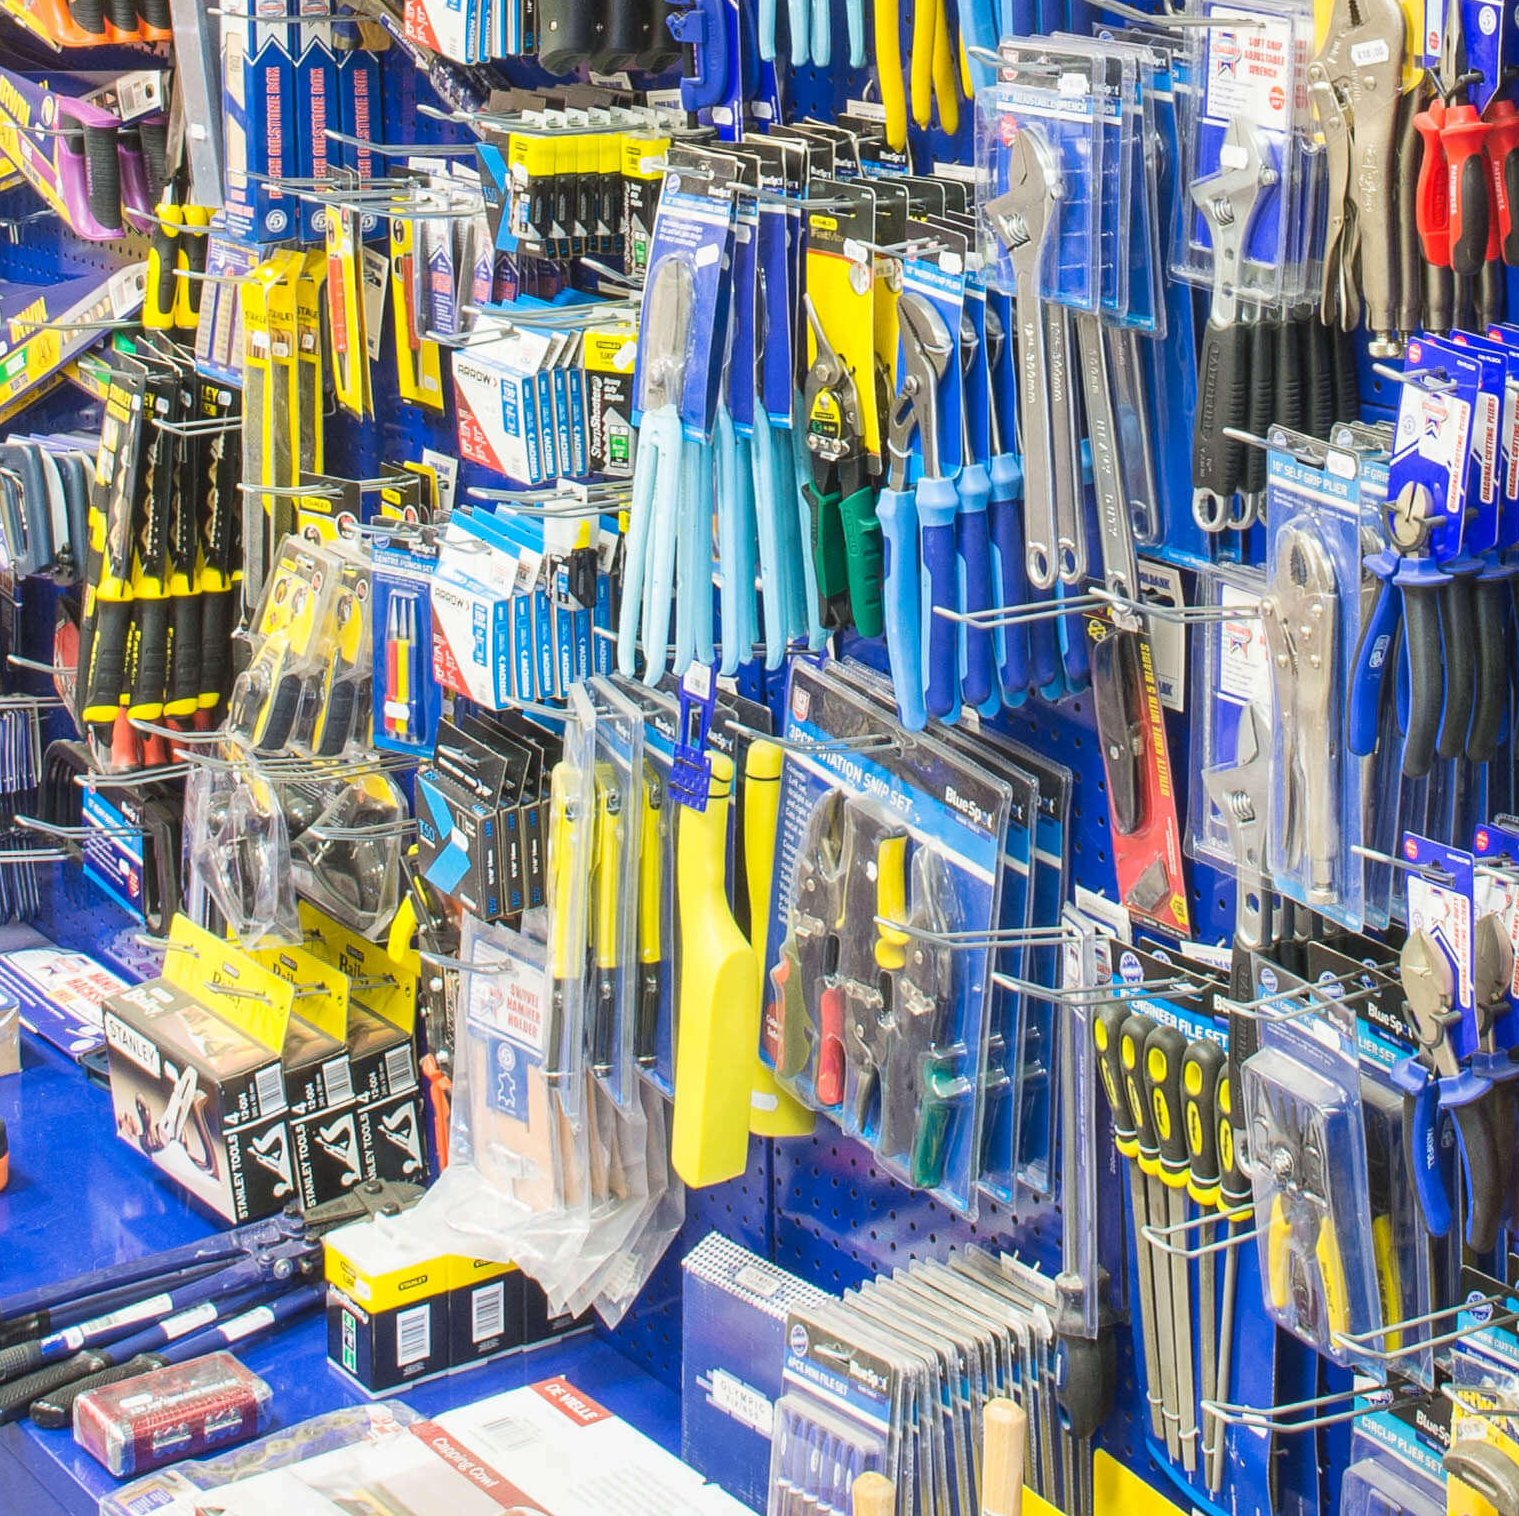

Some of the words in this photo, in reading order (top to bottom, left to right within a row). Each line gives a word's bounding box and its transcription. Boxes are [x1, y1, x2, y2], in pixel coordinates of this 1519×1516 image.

[1243, 49, 1286, 67] ADJUSTABLE
[1246, 36, 1267, 51] SOFT
[1268, 38, 1283, 51] GRIP
[265, 67, 281, 94] BOX
[311, 67, 327, 94] BOX
[1247, 63, 1279, 78] WRENCH
[266, 95, 282, 156] OILSTONE
[311, 95, 327, 156] OILSTONE
[457, 363, 491, 383] ARROW
[590, 382, 602, 459] SharpShooter
[1139, 643, 1152, 683] BLADES
[1148, 698, 1161, 723] WITH
[1151, 725, 1165, 752] KNIFE
[862, 769, 887, 800] SNIP
[889, 788, 913, 813] SET
[1156, 754, 1172, 797] UTILITY
[945, 786, 994, 828] BlueSpot
[506, 994, 540, 1019] HAMMER
[509, 977, 540, 1002] SWIVEL
[507, 1011, 537, 1037] HOLDER
[1178, 1019, 1202, 1041] FILE
[1203, 1029, 1229, 1051] SET
[107, 1019, 158, 1069] STANLEY
[228, 1132, 239, 1168] TOOLS
[298, 1123, 309, 1157] TOOLS
[236, 1169, 251, 1219] STANLEY
[306, 1158, 319, 1208] STANLEY
[544, 1382, 562, 1398] DE
[559, 1389, 606, 1421] VIELLE
[719, 1378, 766, 1415] OLYMPIC
[430, 1434, 478, 1471] Capping
[471, 1462, 499, 1491] Cowl
[1362, 1415, 1396, 1443] CIRCLIP
[1398, 1435, 1423, 1460] PLIER
[1424, 1452, 1442, 1474] SET
